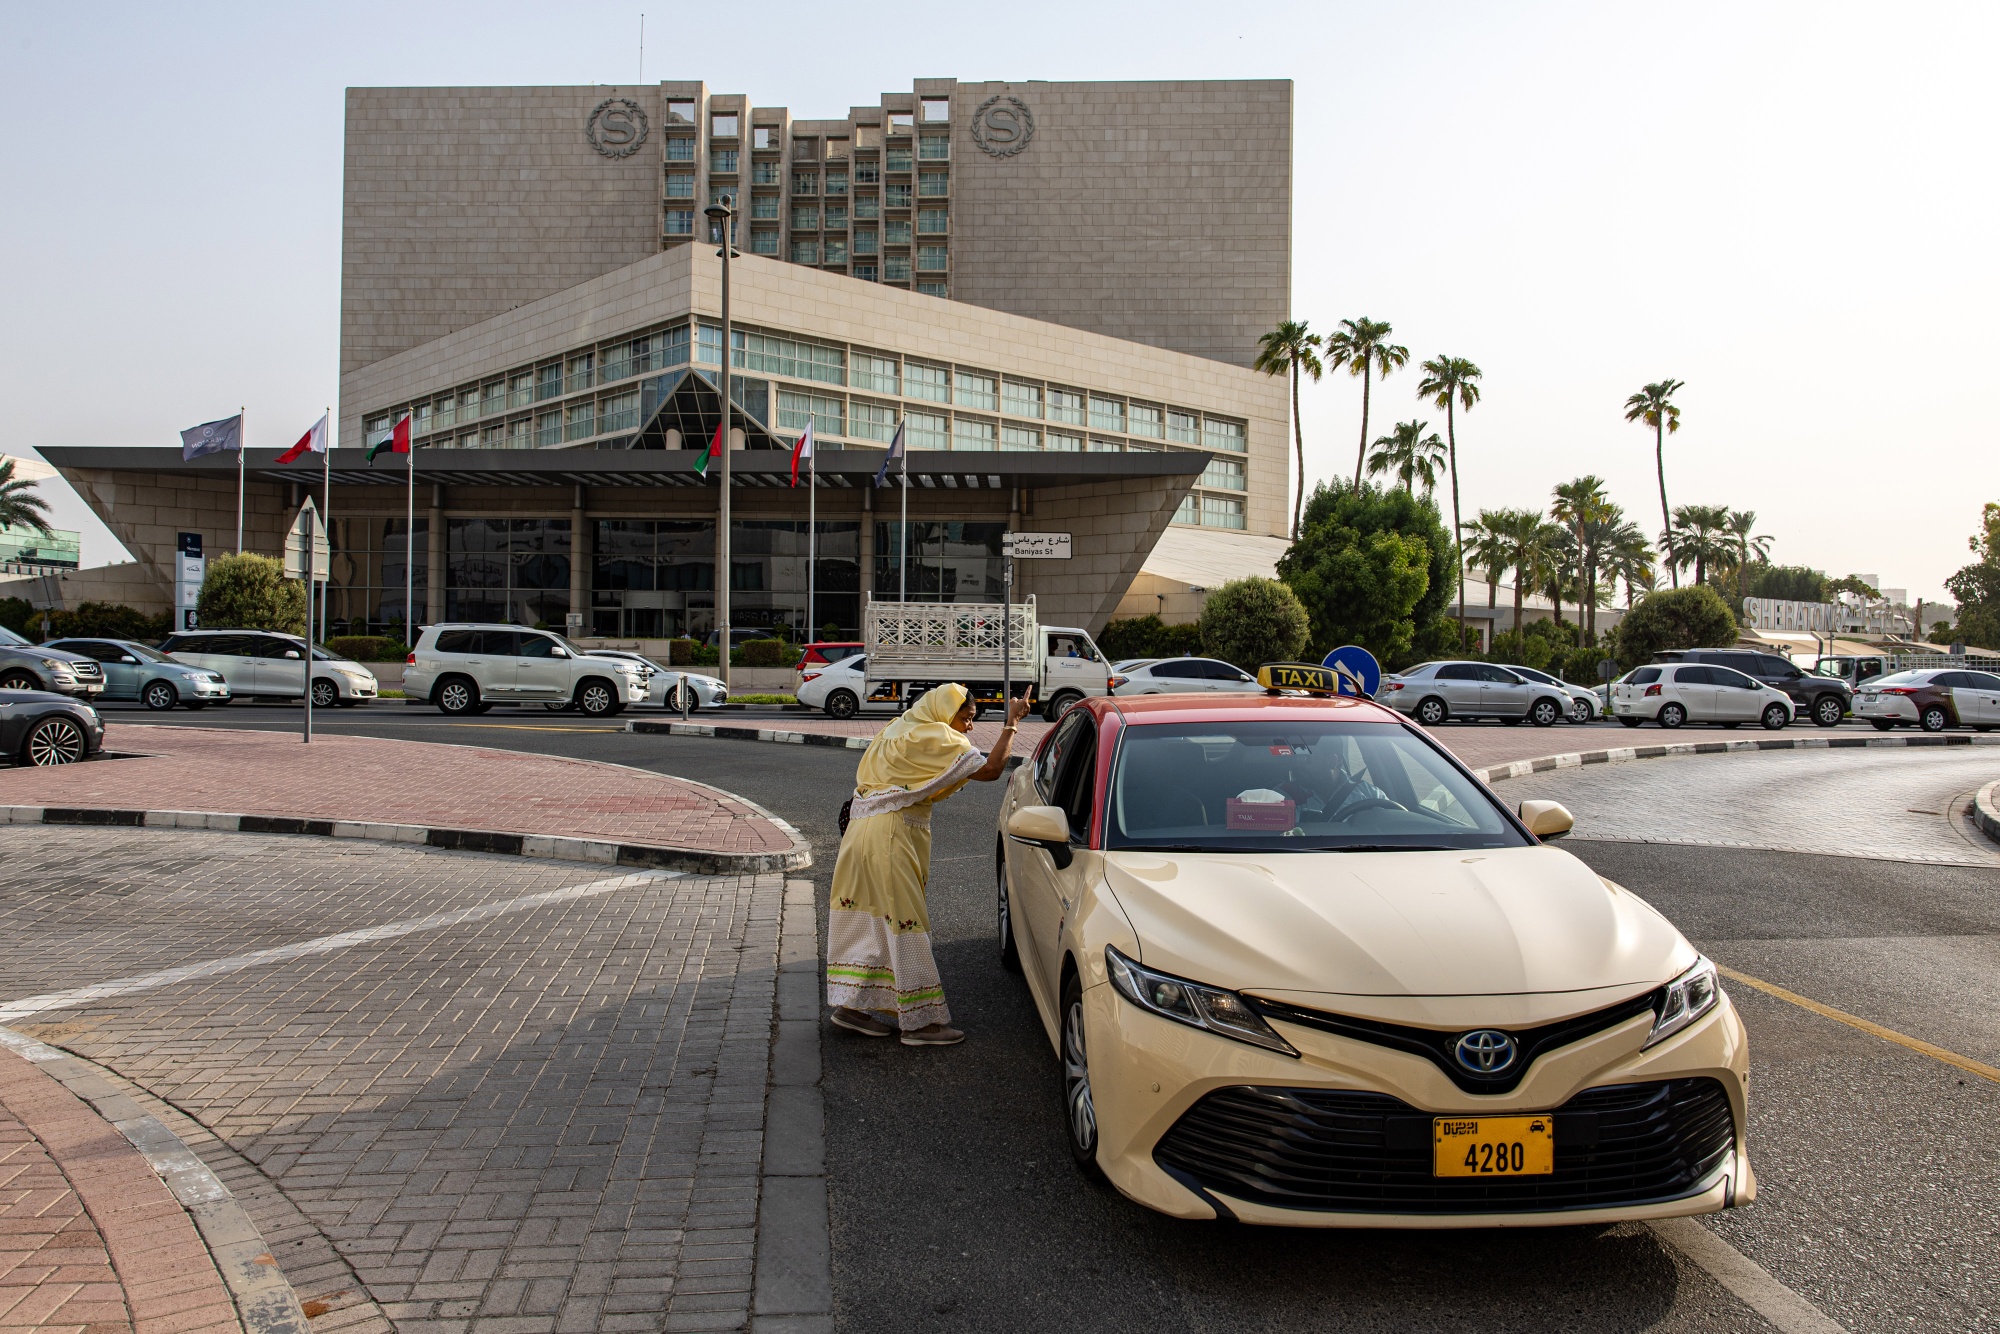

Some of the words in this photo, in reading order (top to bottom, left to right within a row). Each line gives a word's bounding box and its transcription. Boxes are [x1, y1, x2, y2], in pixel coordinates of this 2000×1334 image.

[1048, 536, 1070, 545] شارع
[1014, 548, 1043, 556] Baniyas
[1743, 597, 1834, 632] SHERATON
[1277, 668, 1324, 688] TAXI
[1464, 1142, 1524, 1173] 4280
